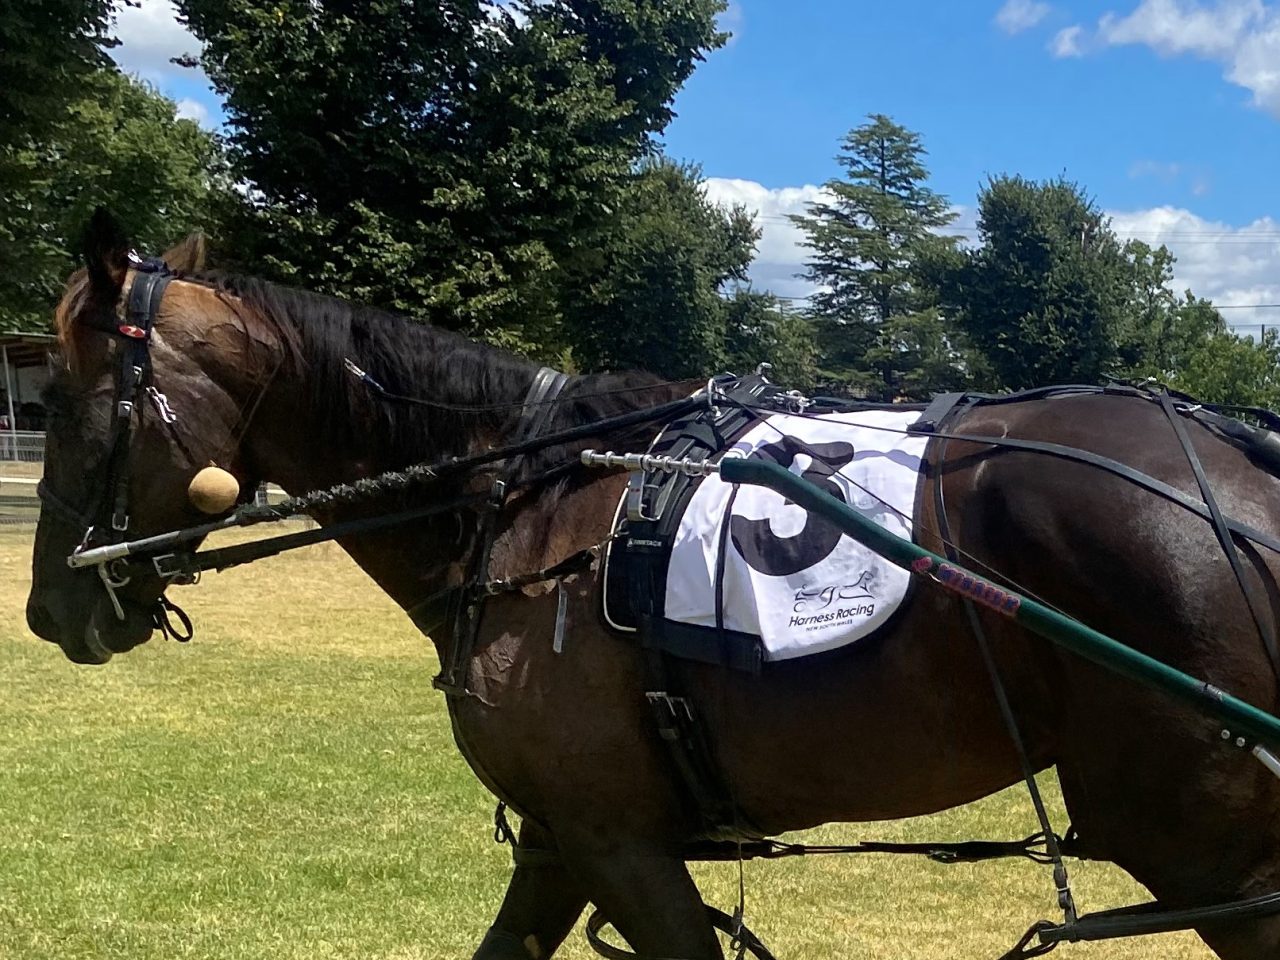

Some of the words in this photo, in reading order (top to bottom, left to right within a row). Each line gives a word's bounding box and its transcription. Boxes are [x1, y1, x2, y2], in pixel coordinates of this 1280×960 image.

[731, 435, 855, 576] 3
[789, 612, 835, 627] Harness
[836, 603, 875, 619] Racing
